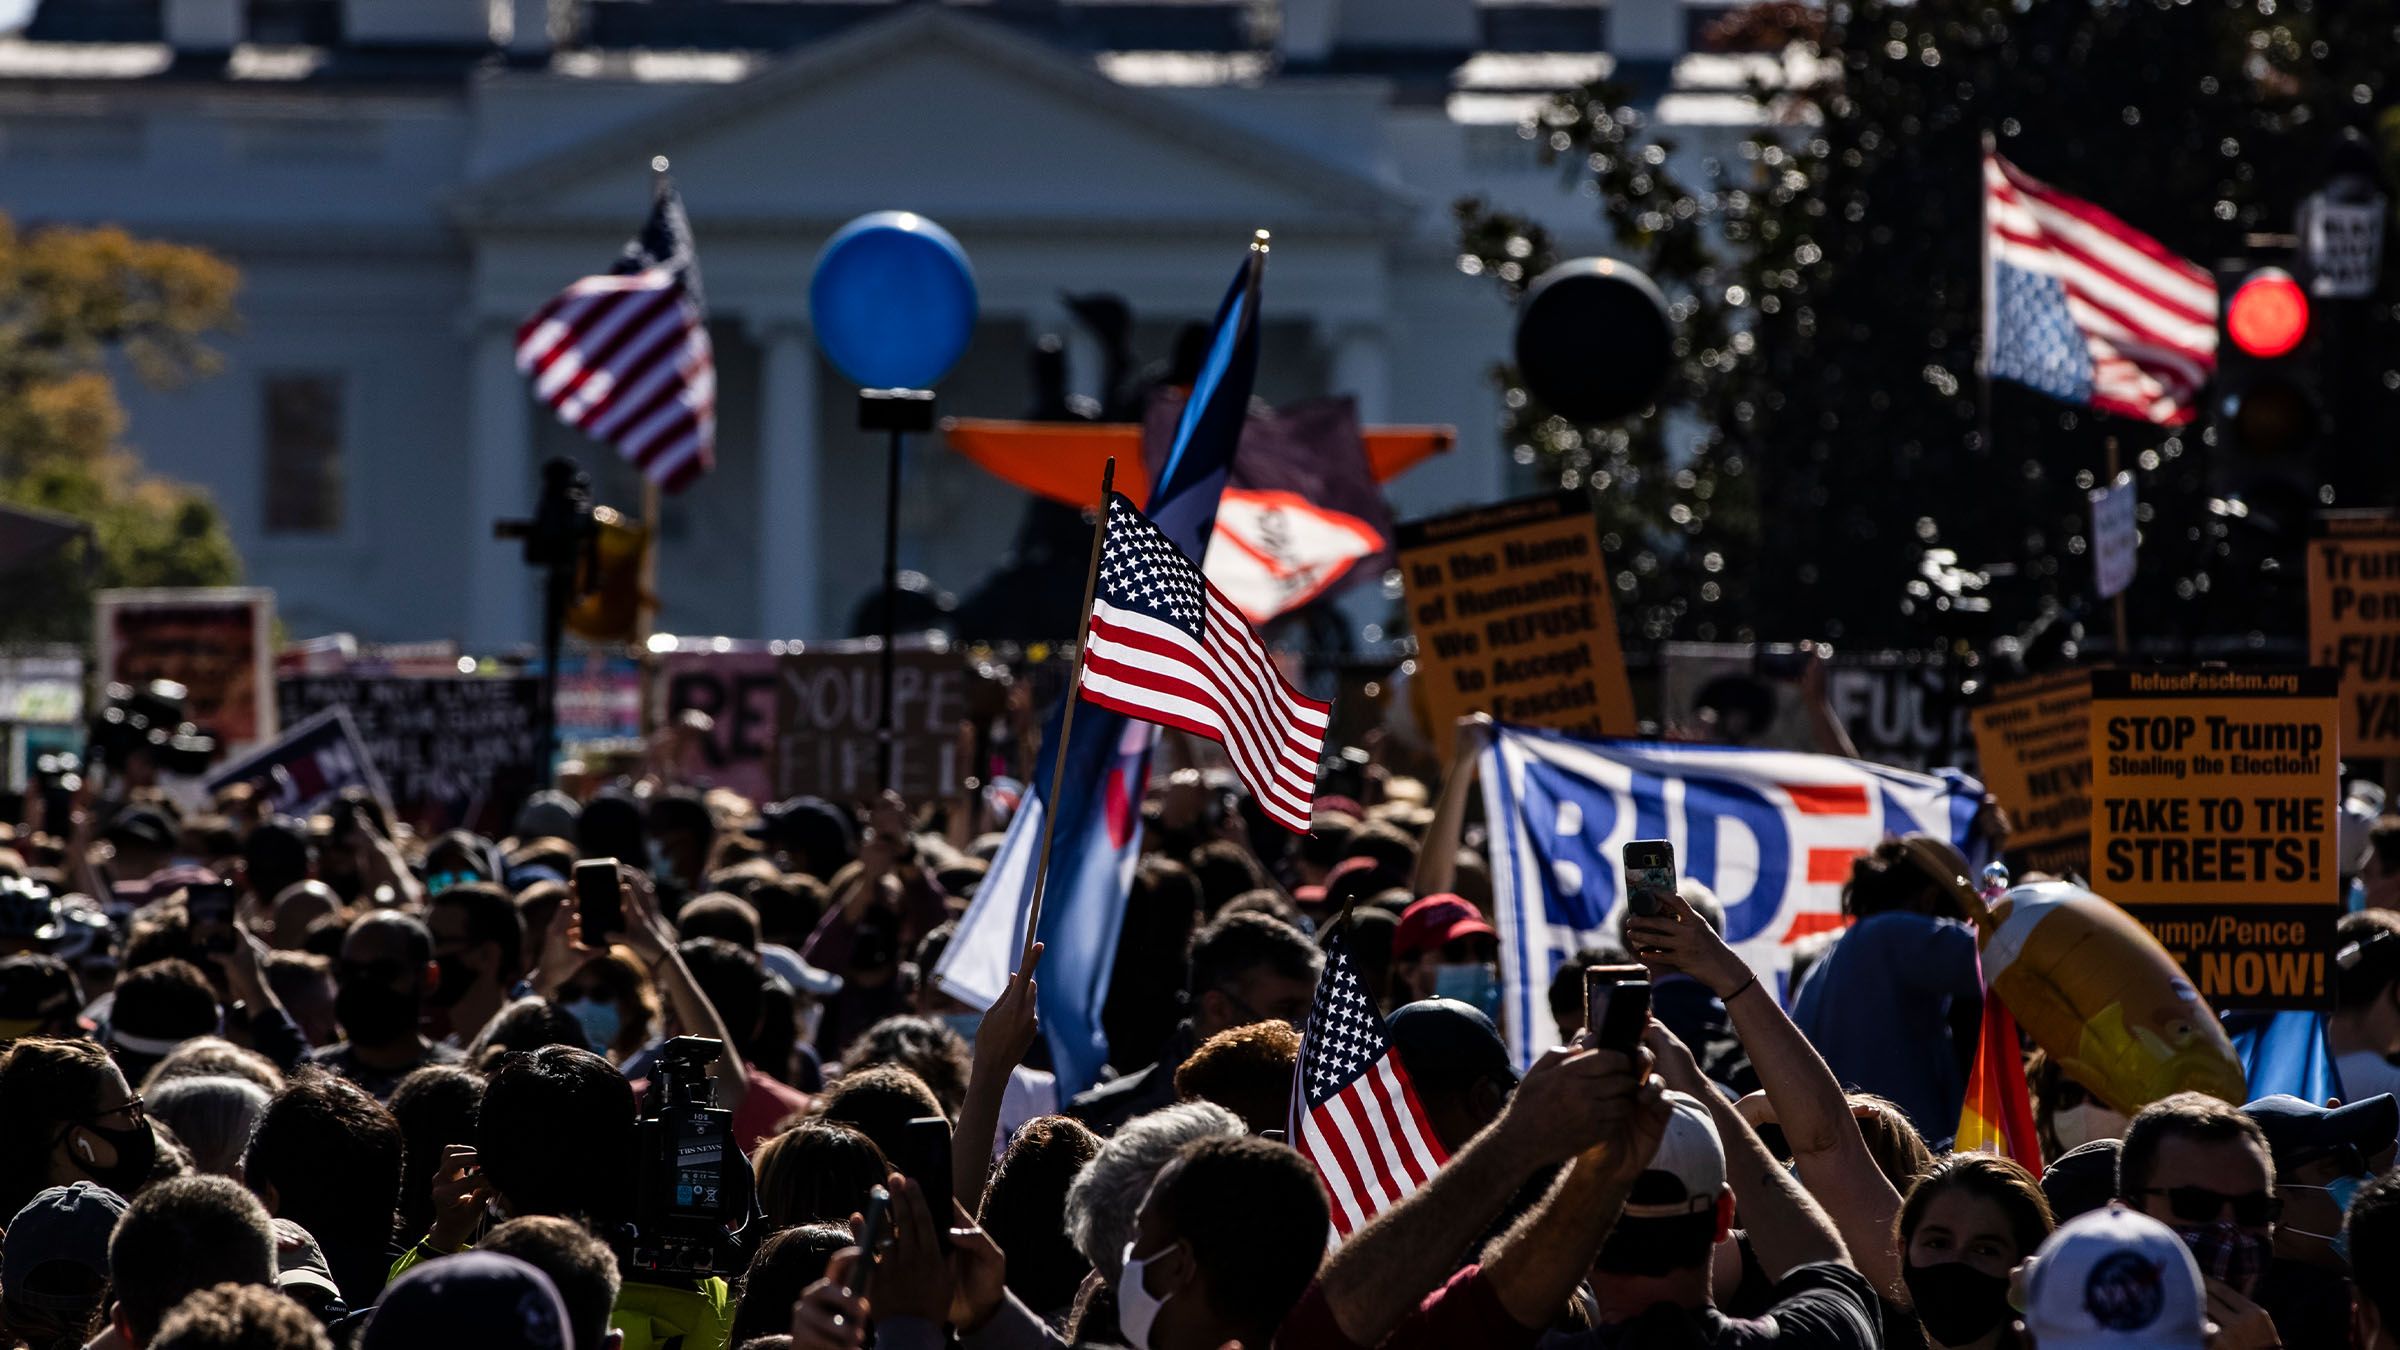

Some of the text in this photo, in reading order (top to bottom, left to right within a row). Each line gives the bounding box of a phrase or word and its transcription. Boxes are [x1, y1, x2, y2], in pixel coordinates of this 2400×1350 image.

[1412, 534, 1588, 588] In the Name
[1419, 595, 1446, 626] of
[1433, 603, 1592, 659] We REFUSE
[1455, 641, 1590, 694] to Accept
[2130, 671, 2300, 695] RefuseFascism.org
[1493, 679, 1597, 723] Fascist
[2108, 716, 2323, 757] STOP Trump
[2028, 758, 2092, 797] NEV
[2109, 755, 2321, 779] Stealing the Election!
[2105, 798, 2325, 832] TAKE TO THE
[2106, 838, 2321, 882] STREETS!
[2144, 914, 2307, 951] ump/Pence
[2201, 951, 2327, 998] NOW!
[696, 1143, 724, 1153] NEWS
[324, 1304, 347, 1313] Canon
